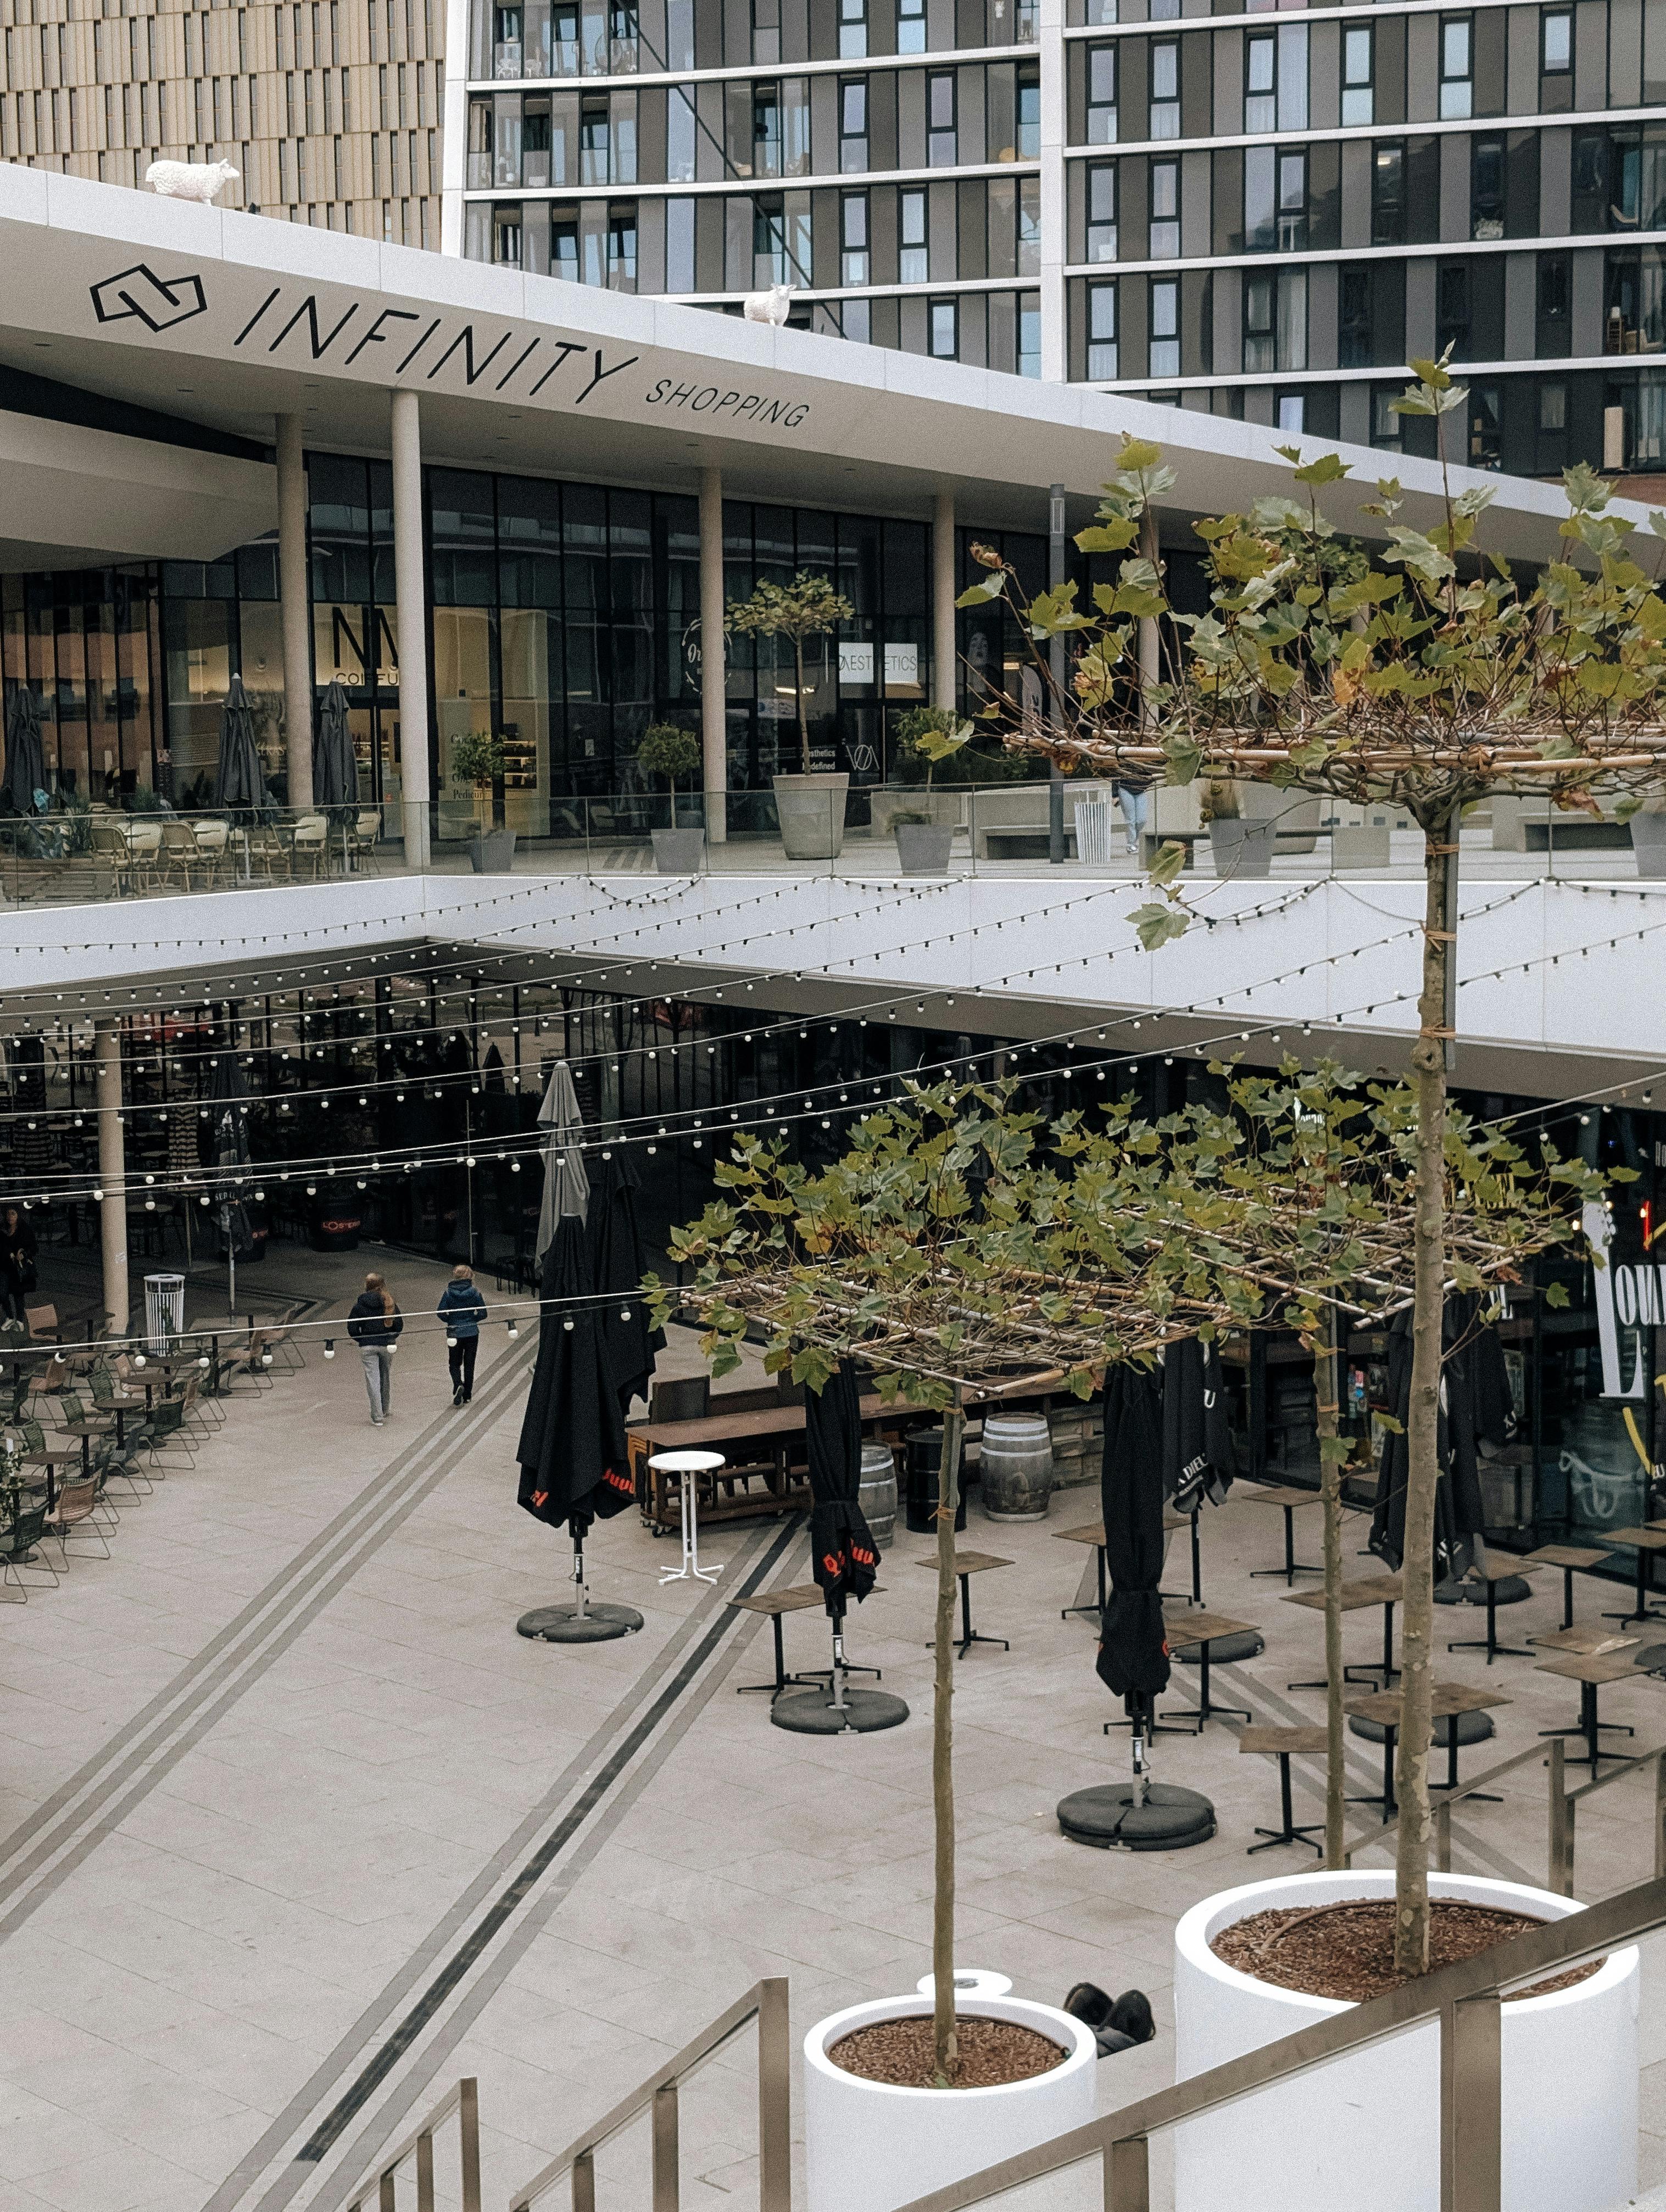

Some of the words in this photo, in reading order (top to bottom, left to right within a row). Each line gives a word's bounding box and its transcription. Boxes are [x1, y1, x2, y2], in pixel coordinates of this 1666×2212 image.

[233, 287, 639, 404] INFINITY
[645, 378, 810, 428] SHOPPING
[803, 748, 835, 757] sthetics
[802, 761, 835, 770] defined
